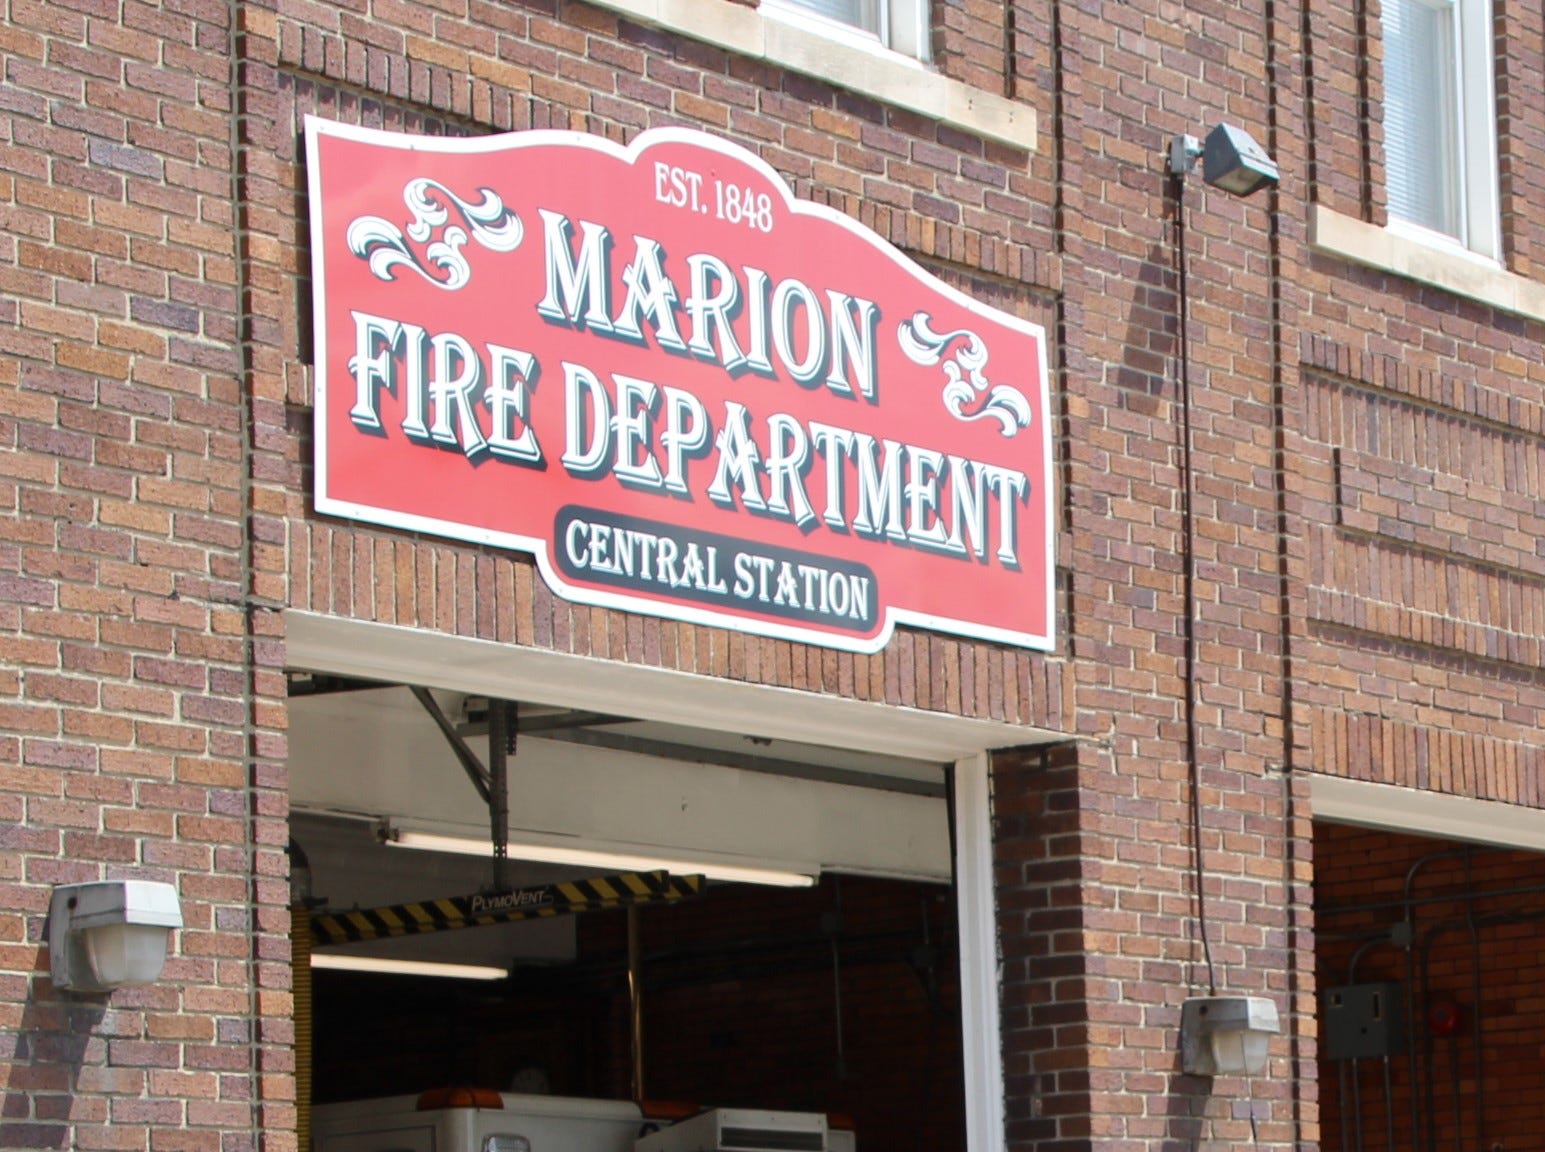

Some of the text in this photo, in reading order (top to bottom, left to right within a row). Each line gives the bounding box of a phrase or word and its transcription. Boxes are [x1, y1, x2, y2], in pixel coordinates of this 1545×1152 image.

[655, 162, 774, 233] EST. 1848
[537, 208, 881, 401] MARION
[348, 310, 1029, 569] FIRE DEPARTMENT
[565, 518, 869, 620] CENTRAL STATION
